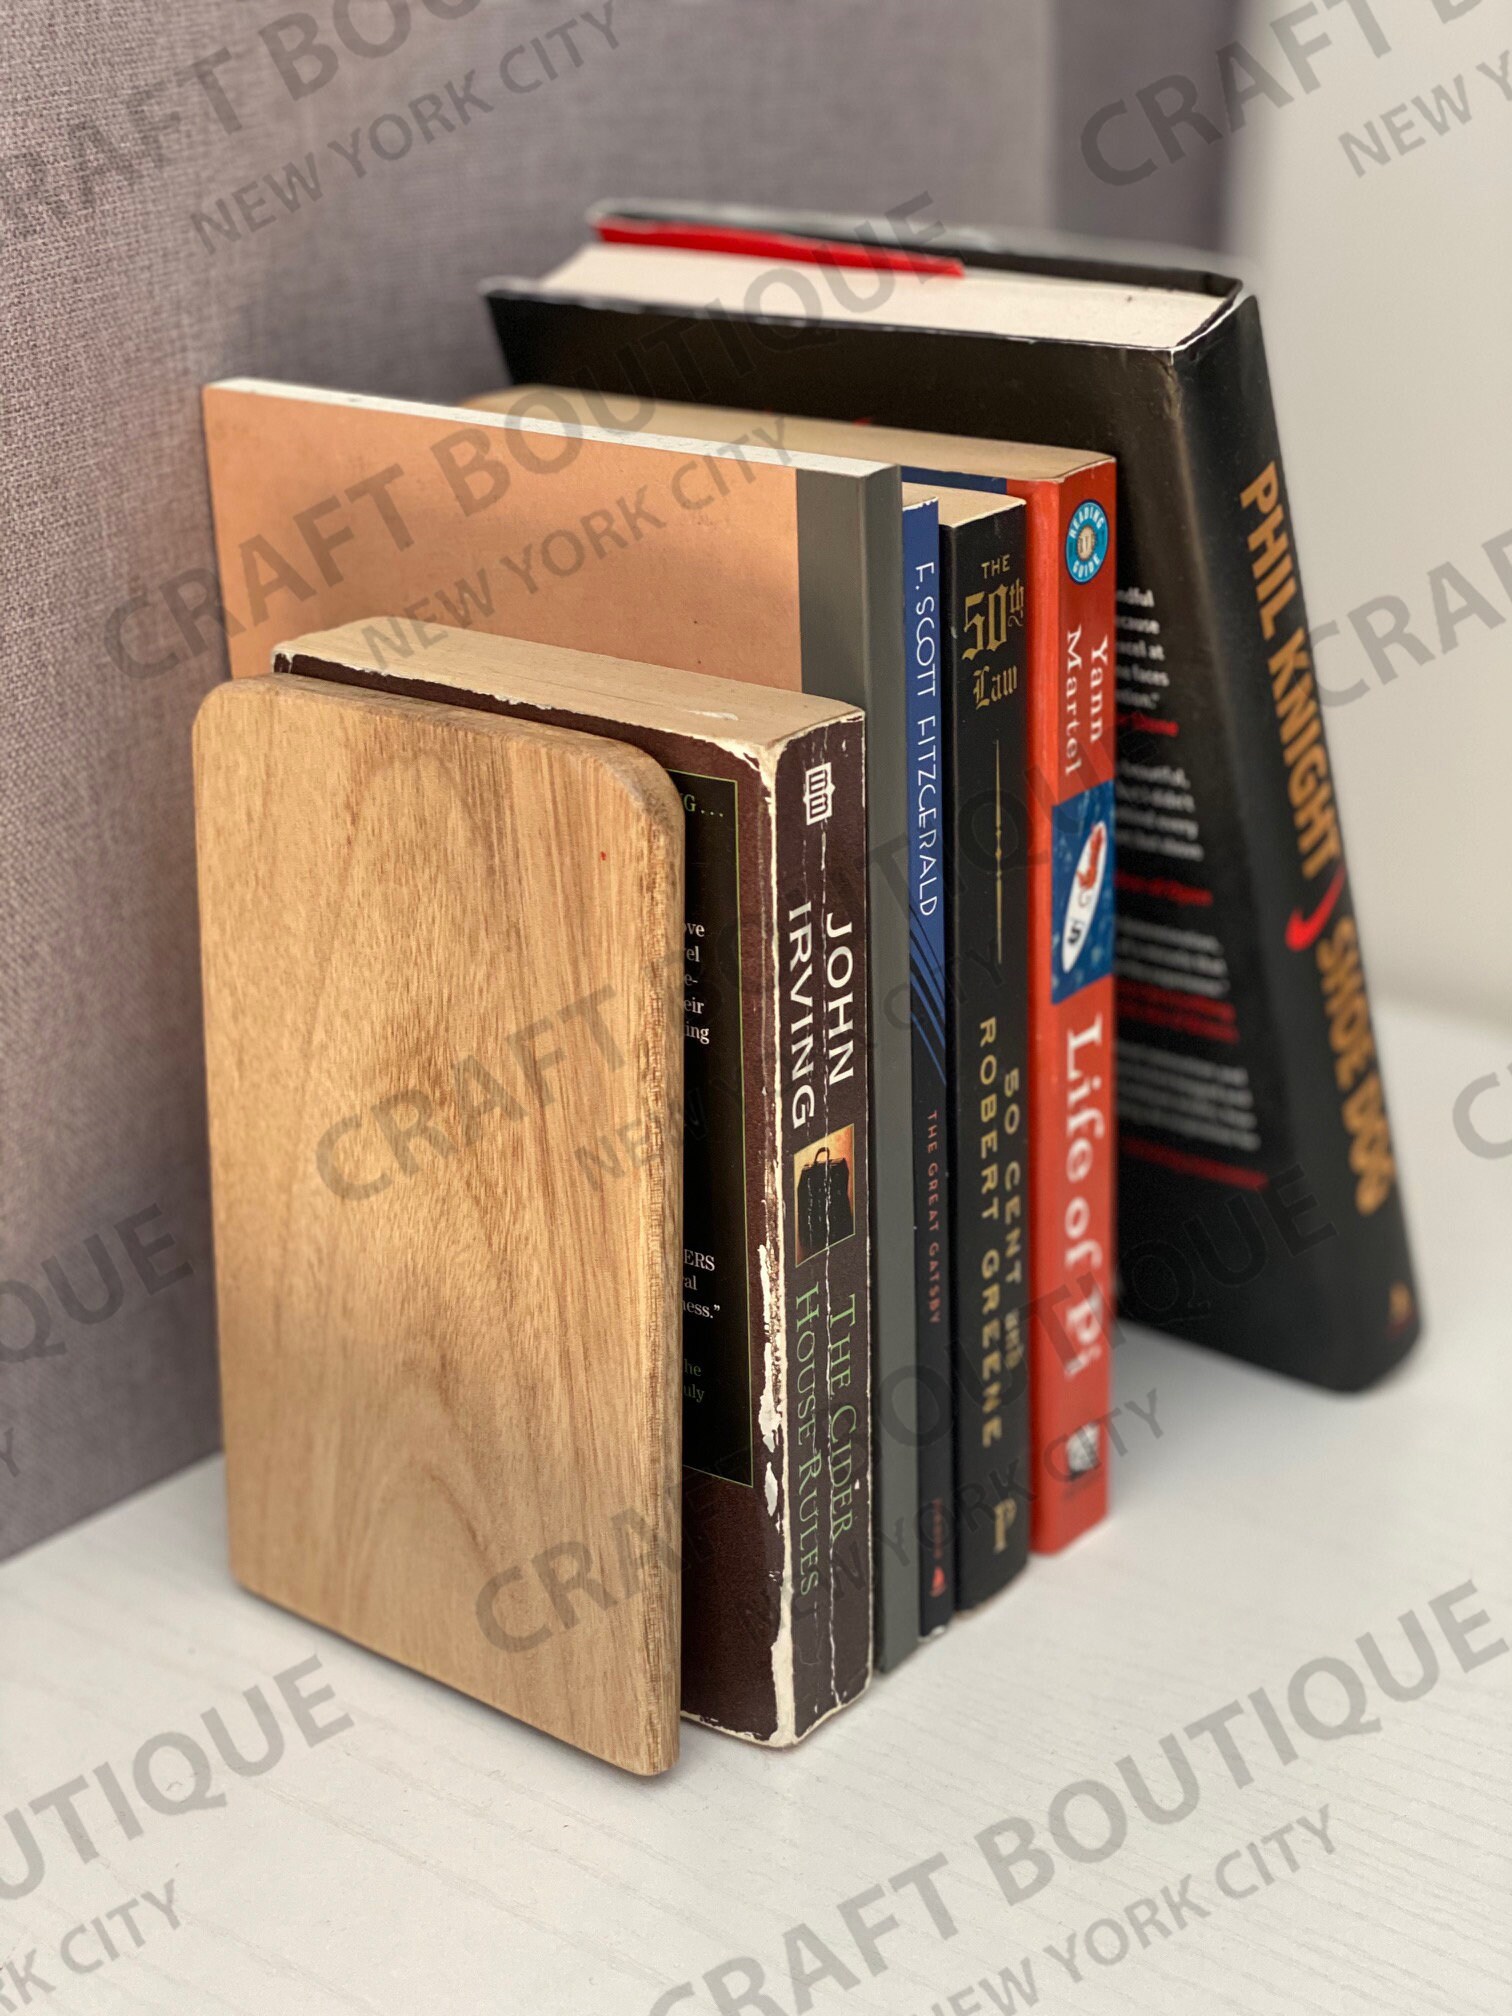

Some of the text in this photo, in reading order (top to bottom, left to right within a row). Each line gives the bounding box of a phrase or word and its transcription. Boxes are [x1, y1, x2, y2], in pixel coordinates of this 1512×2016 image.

[981, 553, 1011, 580] THE
[1068, 505, 1105, 539] READING
[1072, 553, 1101, 578] GUIDE
[961, 578, 1024, 661] 50th
[1240, 461, 1341, 880] PHIL KNIGHT
[915, 561, 938, 917] F. SCOTT FITZGERALD
[972, 664, 1018, 711] Law
[1065, 624, 1083, 777] Martel
[1089, 634, 1109, 744] Yann
[789, 901, 815, 1129] IRVING
[826, 912, 854, 1086] JOHN
[927, 1111, 938, 1154] THE
[979, 1016, 999, 1221] ROBERT
[1004, 1067, 1020, 1136] 50
[1066, 1012, 1105, 1184] Life
[927, 1162, 940, 1232] GREAT
[1004, 1160, 1022, 1284] CENT
[1064, 1195, 1103, 1270] of
[796, 1281, 822, 1597] HOUSE RULES
[829, 1293, 857, 1544] THE CIDER
